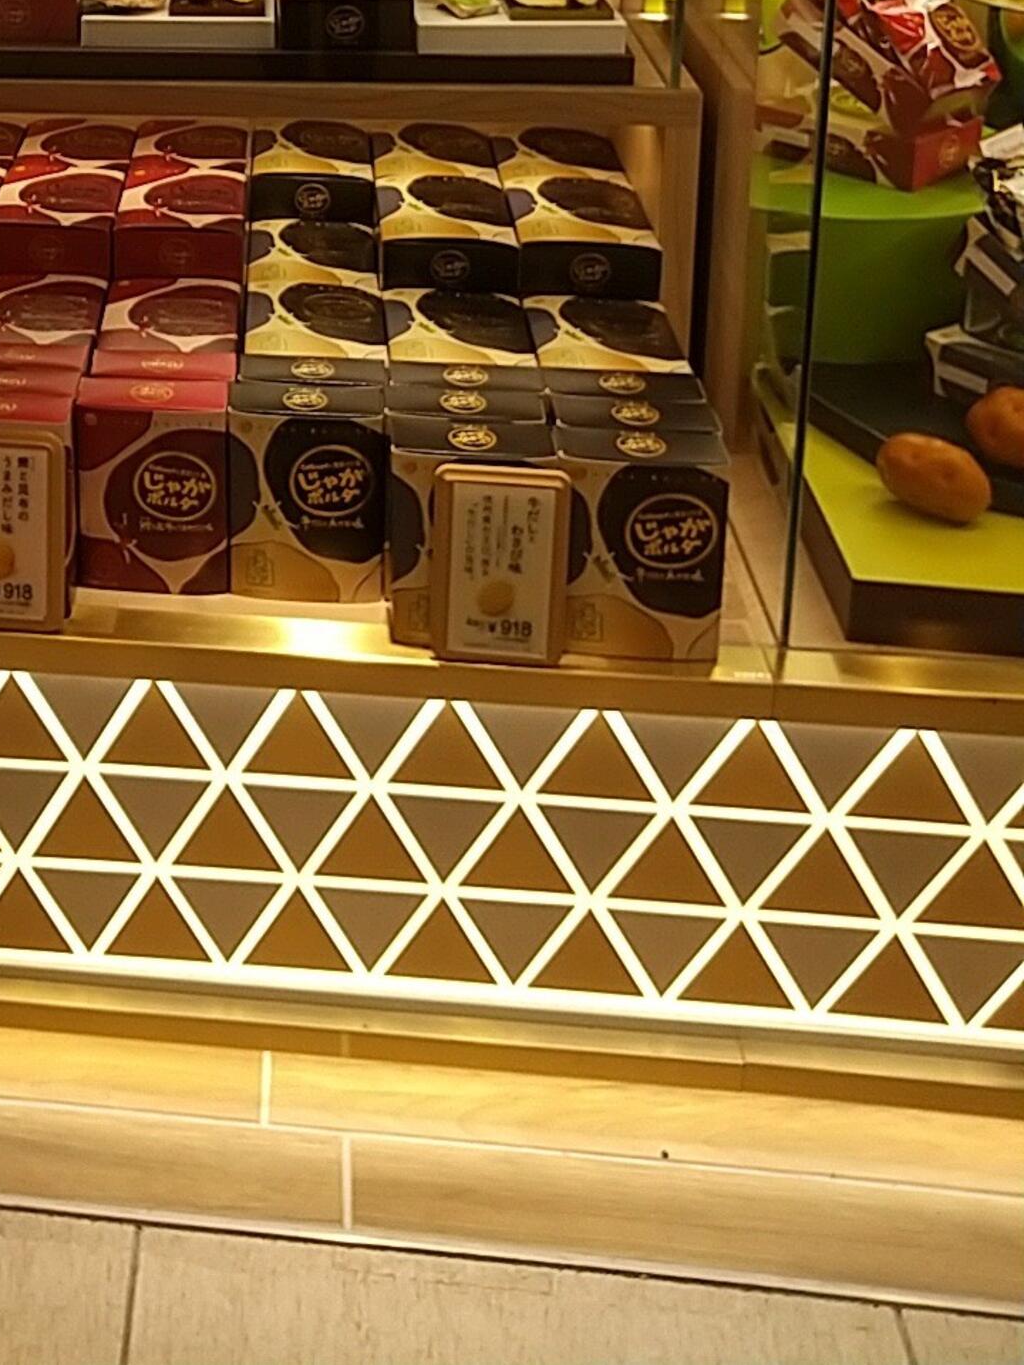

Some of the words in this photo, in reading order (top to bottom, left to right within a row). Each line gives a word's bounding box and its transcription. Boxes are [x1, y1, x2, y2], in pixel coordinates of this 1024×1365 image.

[144, 470, 212, 496] じゃが
[298, 468, 366, 491] じゃが
[147, 490, 199, 511] ボルダ
[307, 488, 361, 504] ボルダ
[635, 517, 712, 541] じゃが
[644, 538, 703, 555] ボルダ
[488, 619, 533, 638] ¥918
